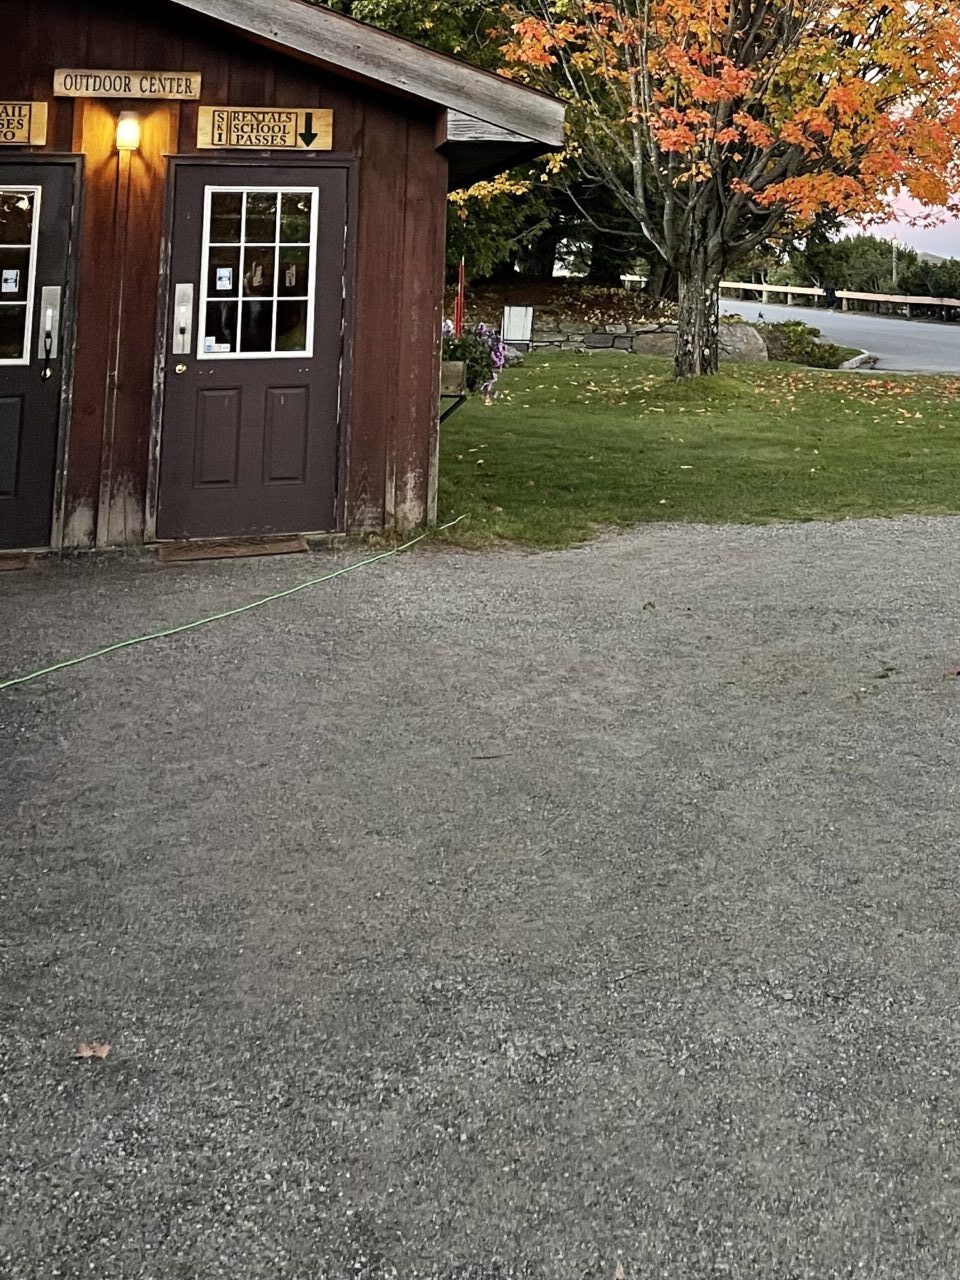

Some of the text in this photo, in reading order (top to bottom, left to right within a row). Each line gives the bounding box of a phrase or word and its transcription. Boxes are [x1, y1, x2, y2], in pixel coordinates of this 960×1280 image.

[63, 73, 193, 94] OUTDOOR CENTER
[232, 111, 293, 123] RENTALS
[232, 123, 291, 135] SCHOOL
[235, 134, 288, 145] PASSES
